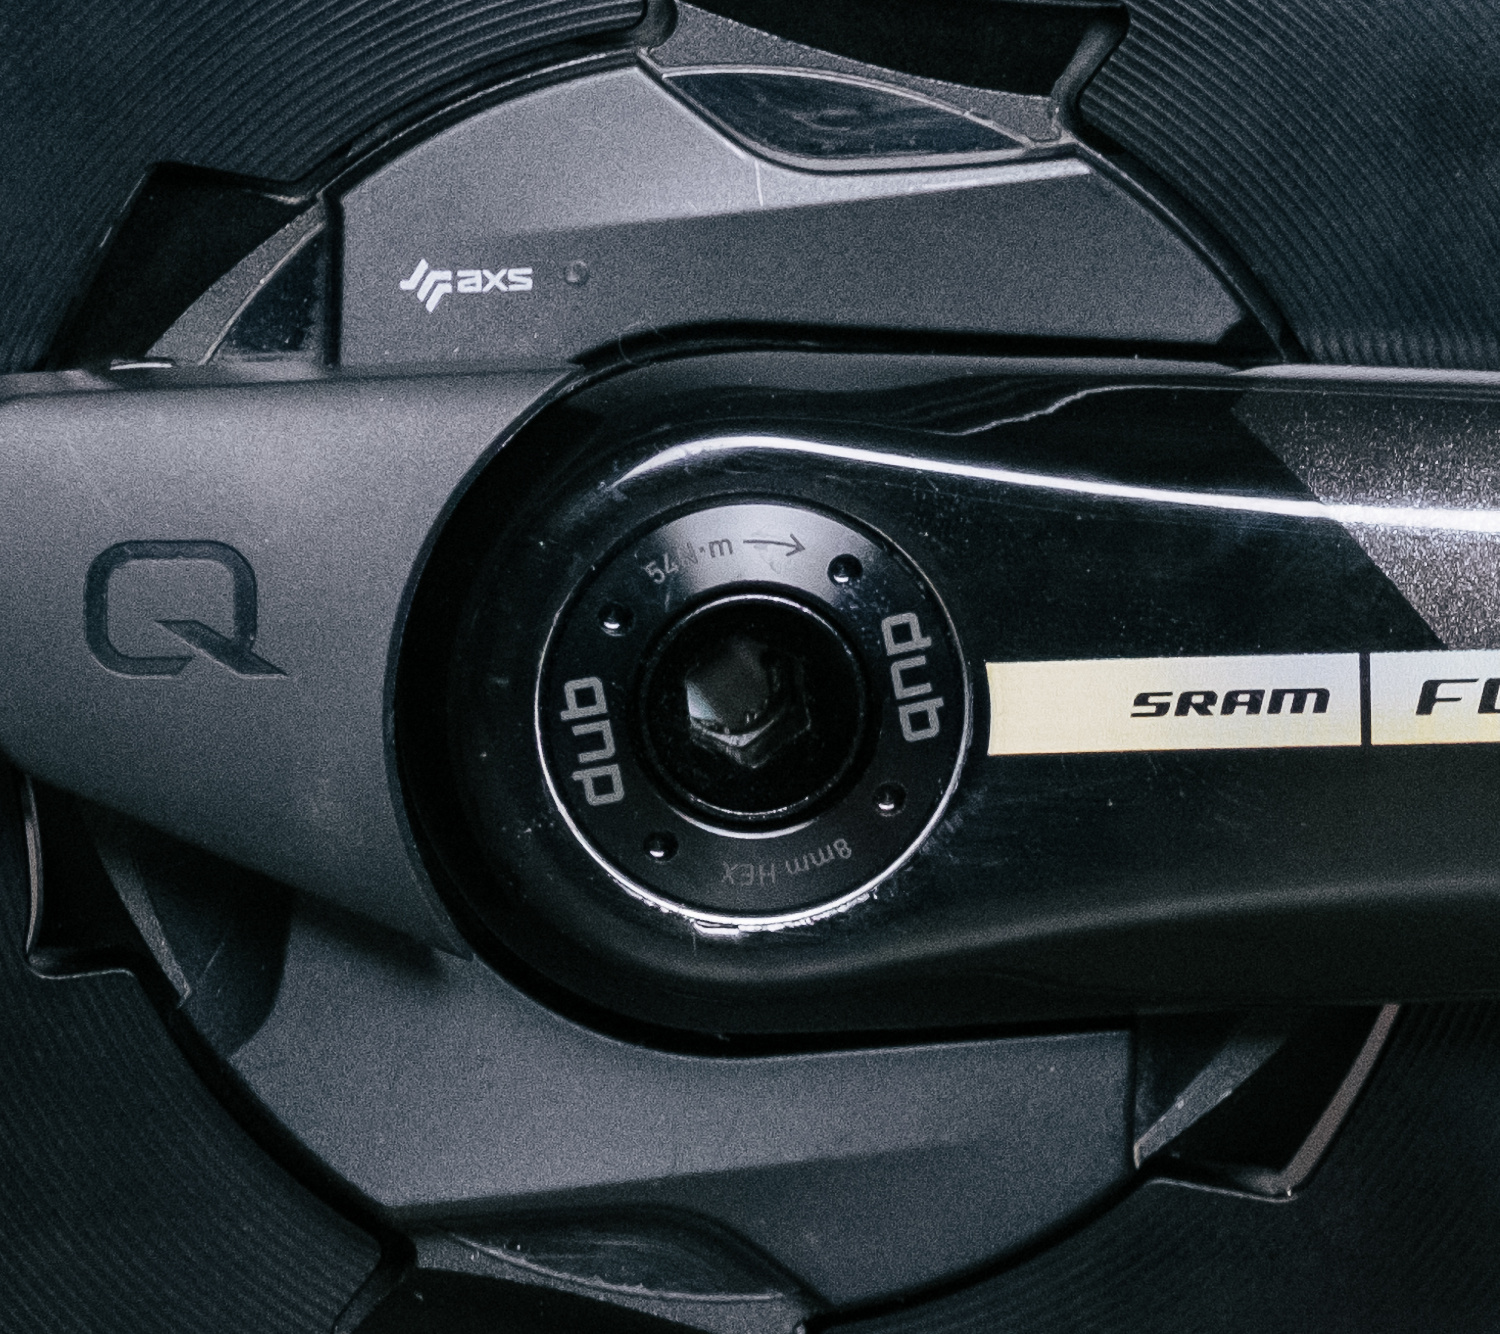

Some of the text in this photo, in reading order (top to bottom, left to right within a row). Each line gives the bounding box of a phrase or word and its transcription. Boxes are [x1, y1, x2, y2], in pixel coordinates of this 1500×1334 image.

[83, 539, 289, 678] Q
[560, 675, 625, 807] dub
[880, 610, 946, 743] dub
[1131, 687, 1331, 718] SRAM
[721, 837, 853, 887] 8mm HEX
